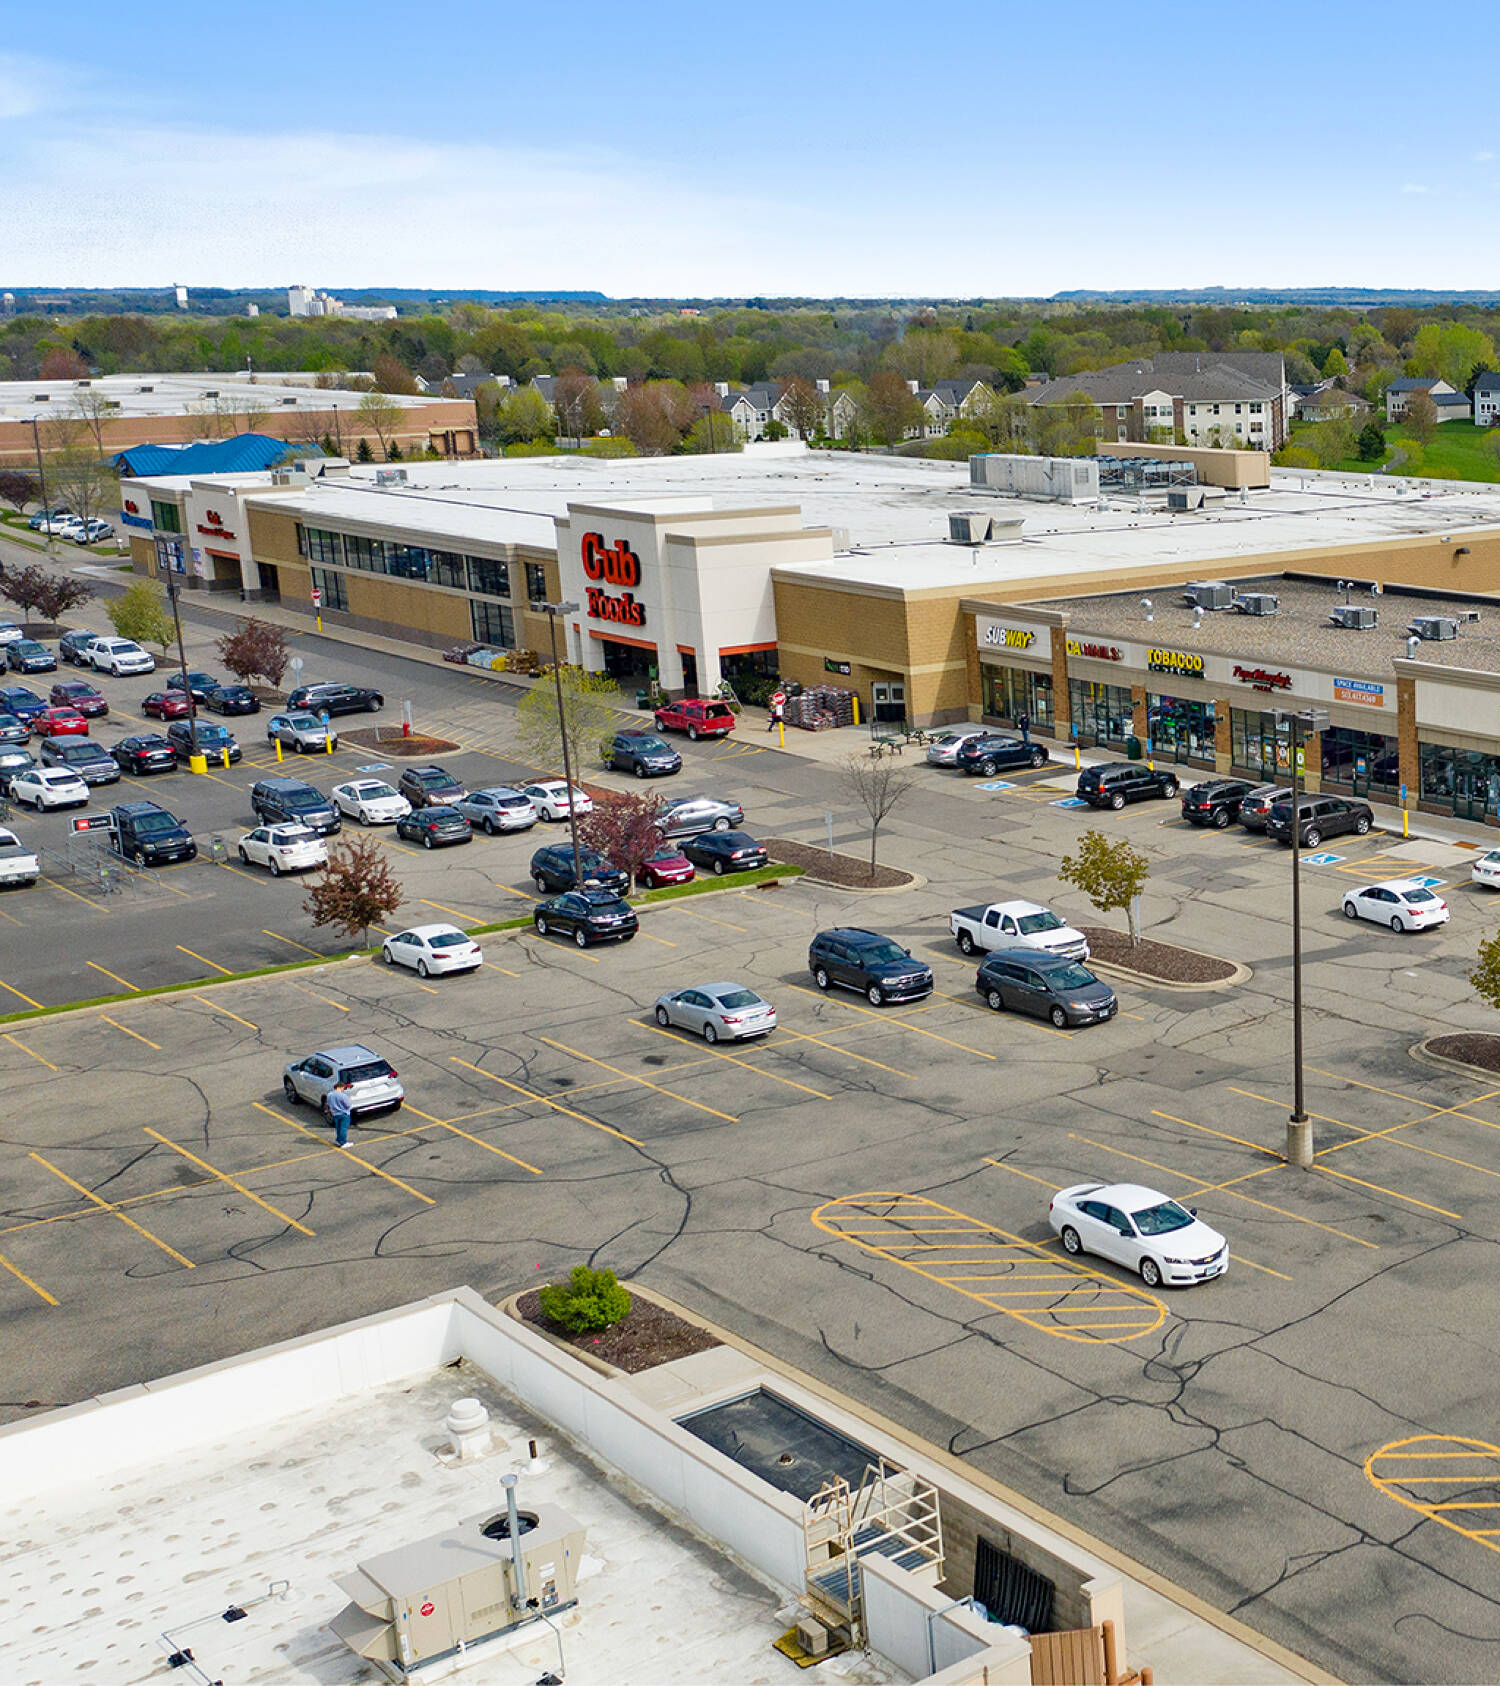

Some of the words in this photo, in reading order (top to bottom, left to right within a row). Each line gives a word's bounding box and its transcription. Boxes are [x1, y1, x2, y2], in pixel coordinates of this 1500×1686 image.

[581, 532, 641, 587] Cub
[585, 587, 646, 625] Foods
[985, 626, 1035, 648] SUBWAY
[1147, 648, 1204, 670] TOBACCO
